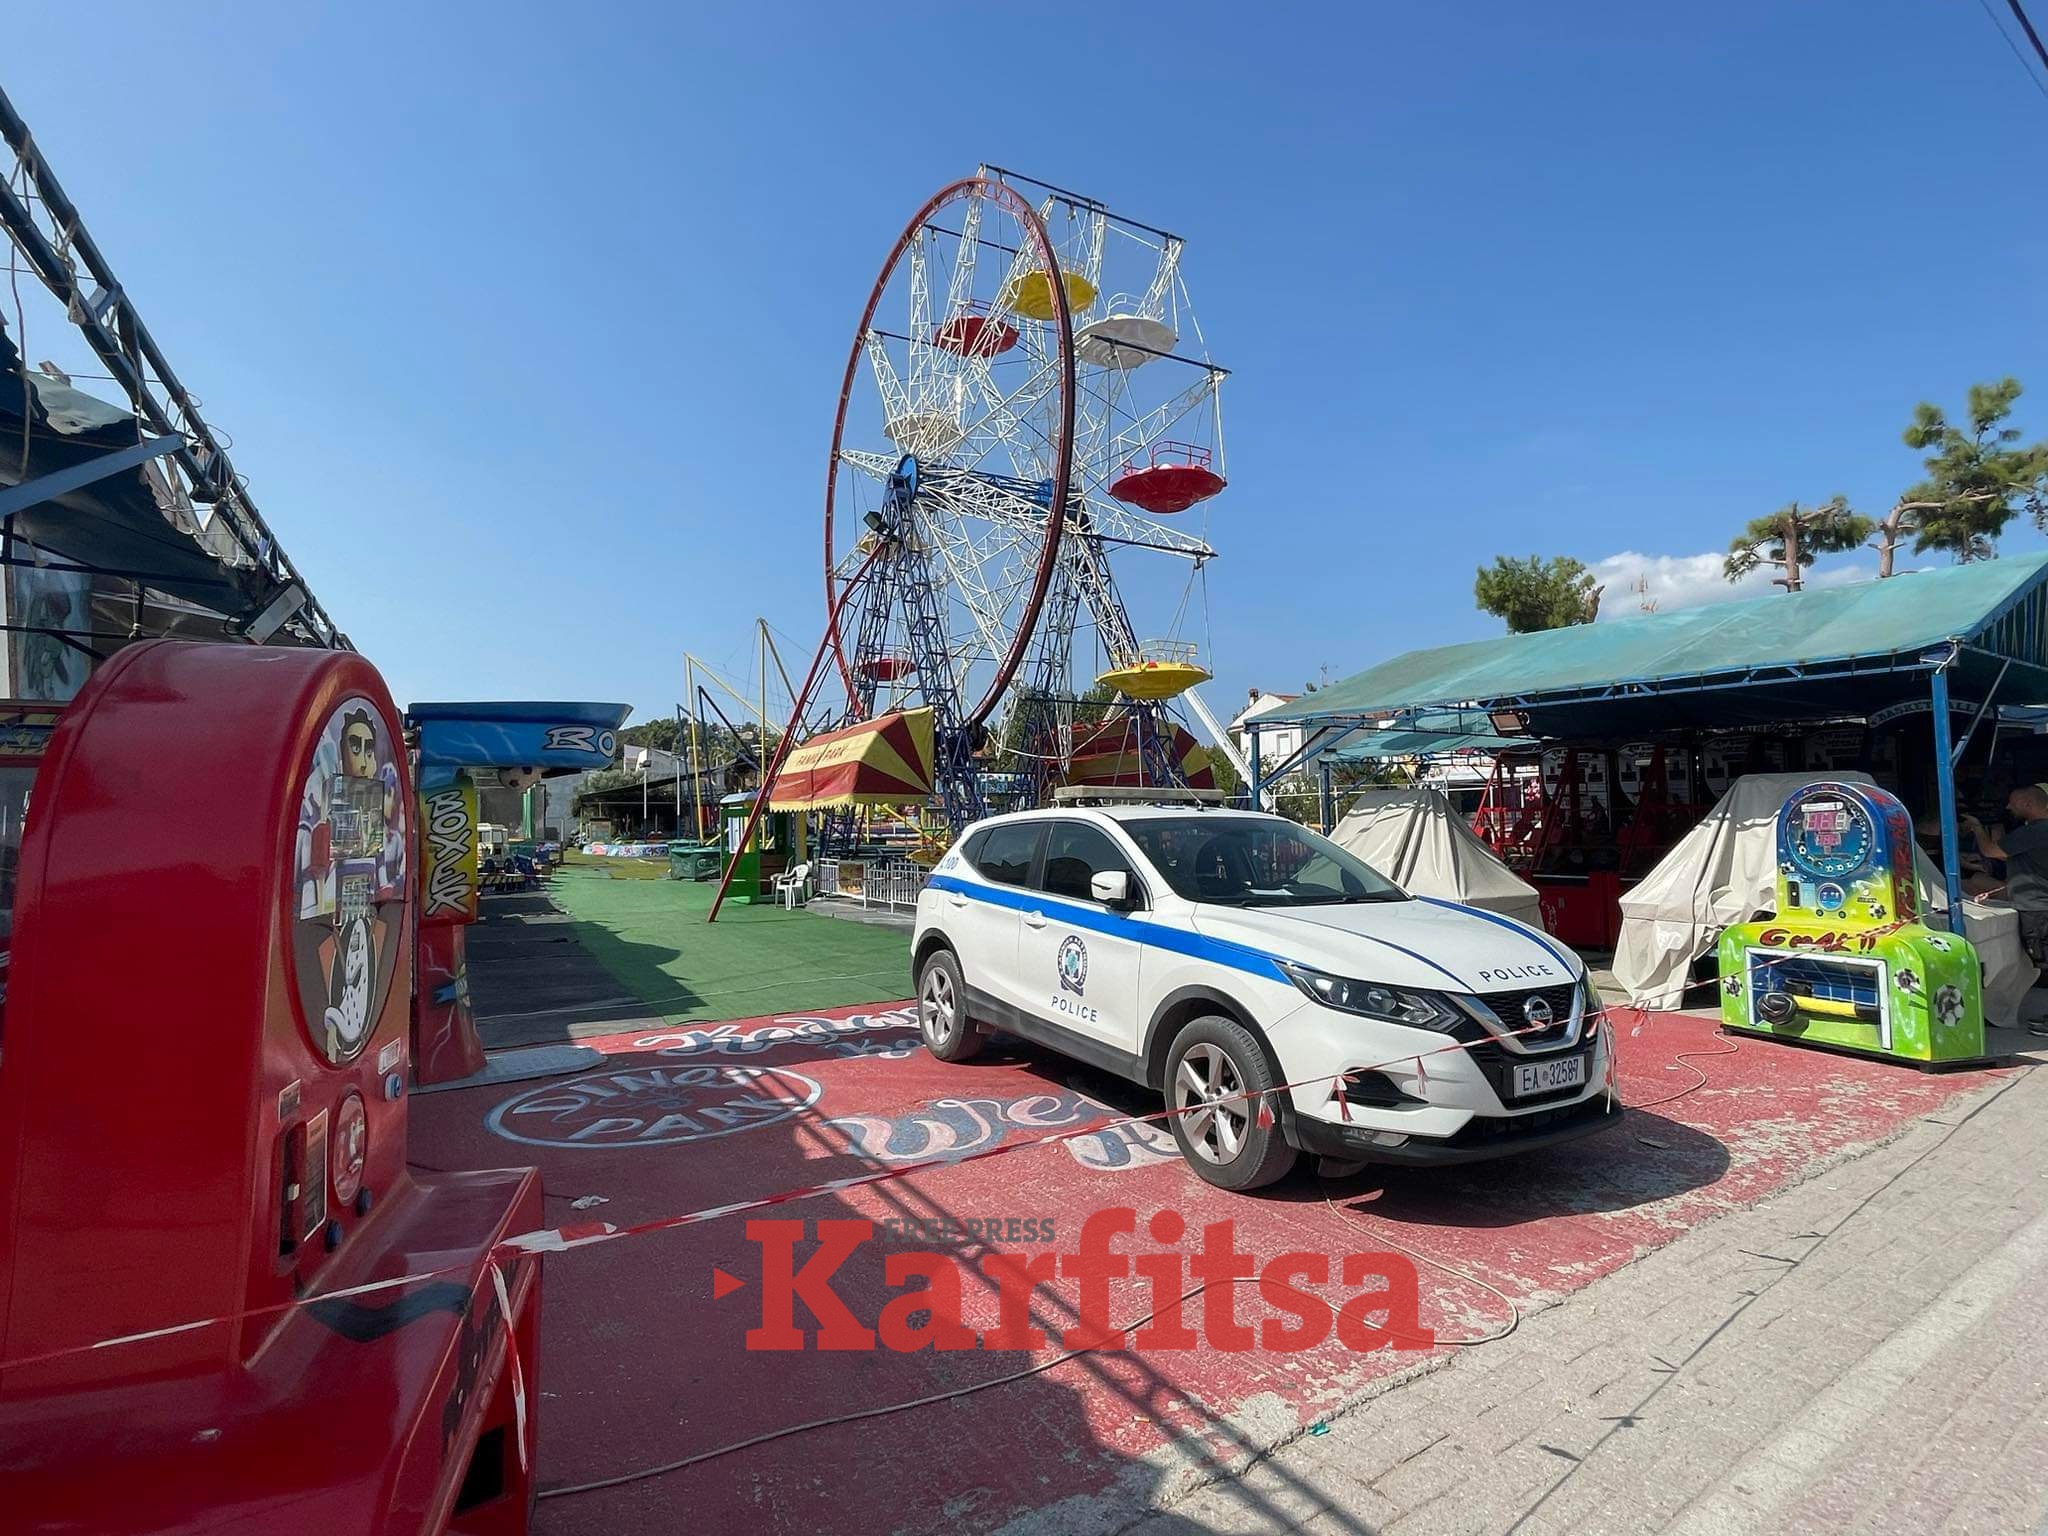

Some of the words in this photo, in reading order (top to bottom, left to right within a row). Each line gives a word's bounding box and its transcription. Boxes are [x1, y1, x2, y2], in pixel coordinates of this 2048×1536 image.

[425, 790, 473, 916] BOXER
[1479, 964, 1554, 983] POLICE
[1051, 996, 1098, 1023] POLICE
[1550, 1058, 1579, 1086] 32587
[567, 1095, 797, 1140] PARK
